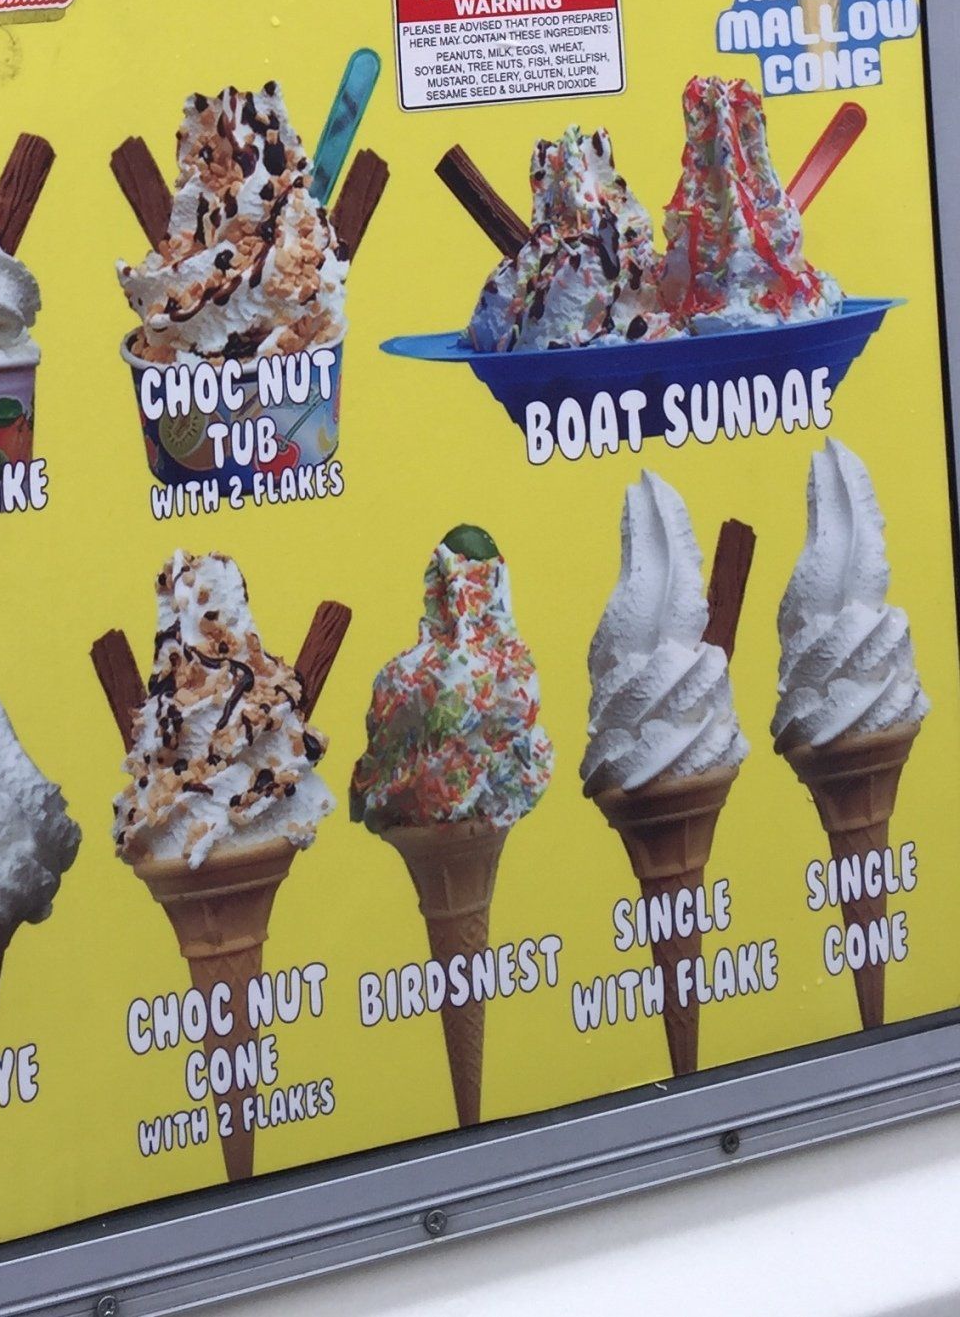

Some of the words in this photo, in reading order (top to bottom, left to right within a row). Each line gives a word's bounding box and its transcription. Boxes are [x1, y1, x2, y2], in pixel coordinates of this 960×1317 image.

[403, 24, 441, 36] PLEASE
[444, 22, 457, 33] BE
[459, 20, 502, 32] ADVISED
[505, 18, 529, 29] THAT
[532, 15, 560, 27] FOOD
[562, 11, 613, 24] PREPARED
[410, 37, 438, 48] HERE
[440, 35, 460, 46] MAY
[463, 32, 507, 45] CONTAIN
[509, 29, 541, 41] THESE
[544, 25, 611, 38] INGREDIENTS:
[436, 49, 486, 62] PEANUTS,
[488, 46, 513, 58] MILK,
[516, 44, 547, 56] EGGS,
[549, 41, 585, 53] WHEAT,
[415, 64, 465, 76] SOYBEAN,
[467, 61, 494, 72] TREE
[496, 59, 526, 70] NUTS,
[528, 56, 553, 68] FISH,
[555, 52, 610, 65] SHELLFISH,
[426, 88, 468, 101] SESAME
[470, 85, 497, 97] SEED
[499, 84, 507, 95] &
[508, 81, 555, 94] SULPHUR
[557, 77, 597, 90] DIOXIDE
[427, 75, 481, 88] MUSTARD,
[481, 71, 521, 84] CELERY,
[524, 68, 566, 80] GLUTEN,
[568, 65, 599, 77] LUPIN,
[762, 47, 881, 95] CONE
[139, 358, 246, 421] CHOC
[256, 347, 337, 409] NUT
[524, 387, 648, 466] BOAT
[662, 365, 834, 450] SUNDAE
[206, 415, 279, 471] TUB
[149, 477, 220, 522] WITH
[228, 477, 245, 510] 2
[252, 460, 346, 506] FLAKES
[805, 840, 918, 912] SINGLE
[612, 878, 733, 952] SINGLE
[822, 911, 910, 977] CONE
[126, 980, 233, 1056] CHOC
[246, 961, 328, 1031] NUT
[358, 934, 563, 1028] BIRDSNEST
[571, 963, 666, 1033] WITH
[675, 938, 779, 1008] FLAKE
[184, 1034, 279, 1103] CONE
[138, 1105, 209, 1158] WITH
[218, 1102, 234, 1138] 2
[241, 1077, 336, 1134] FLAKES
